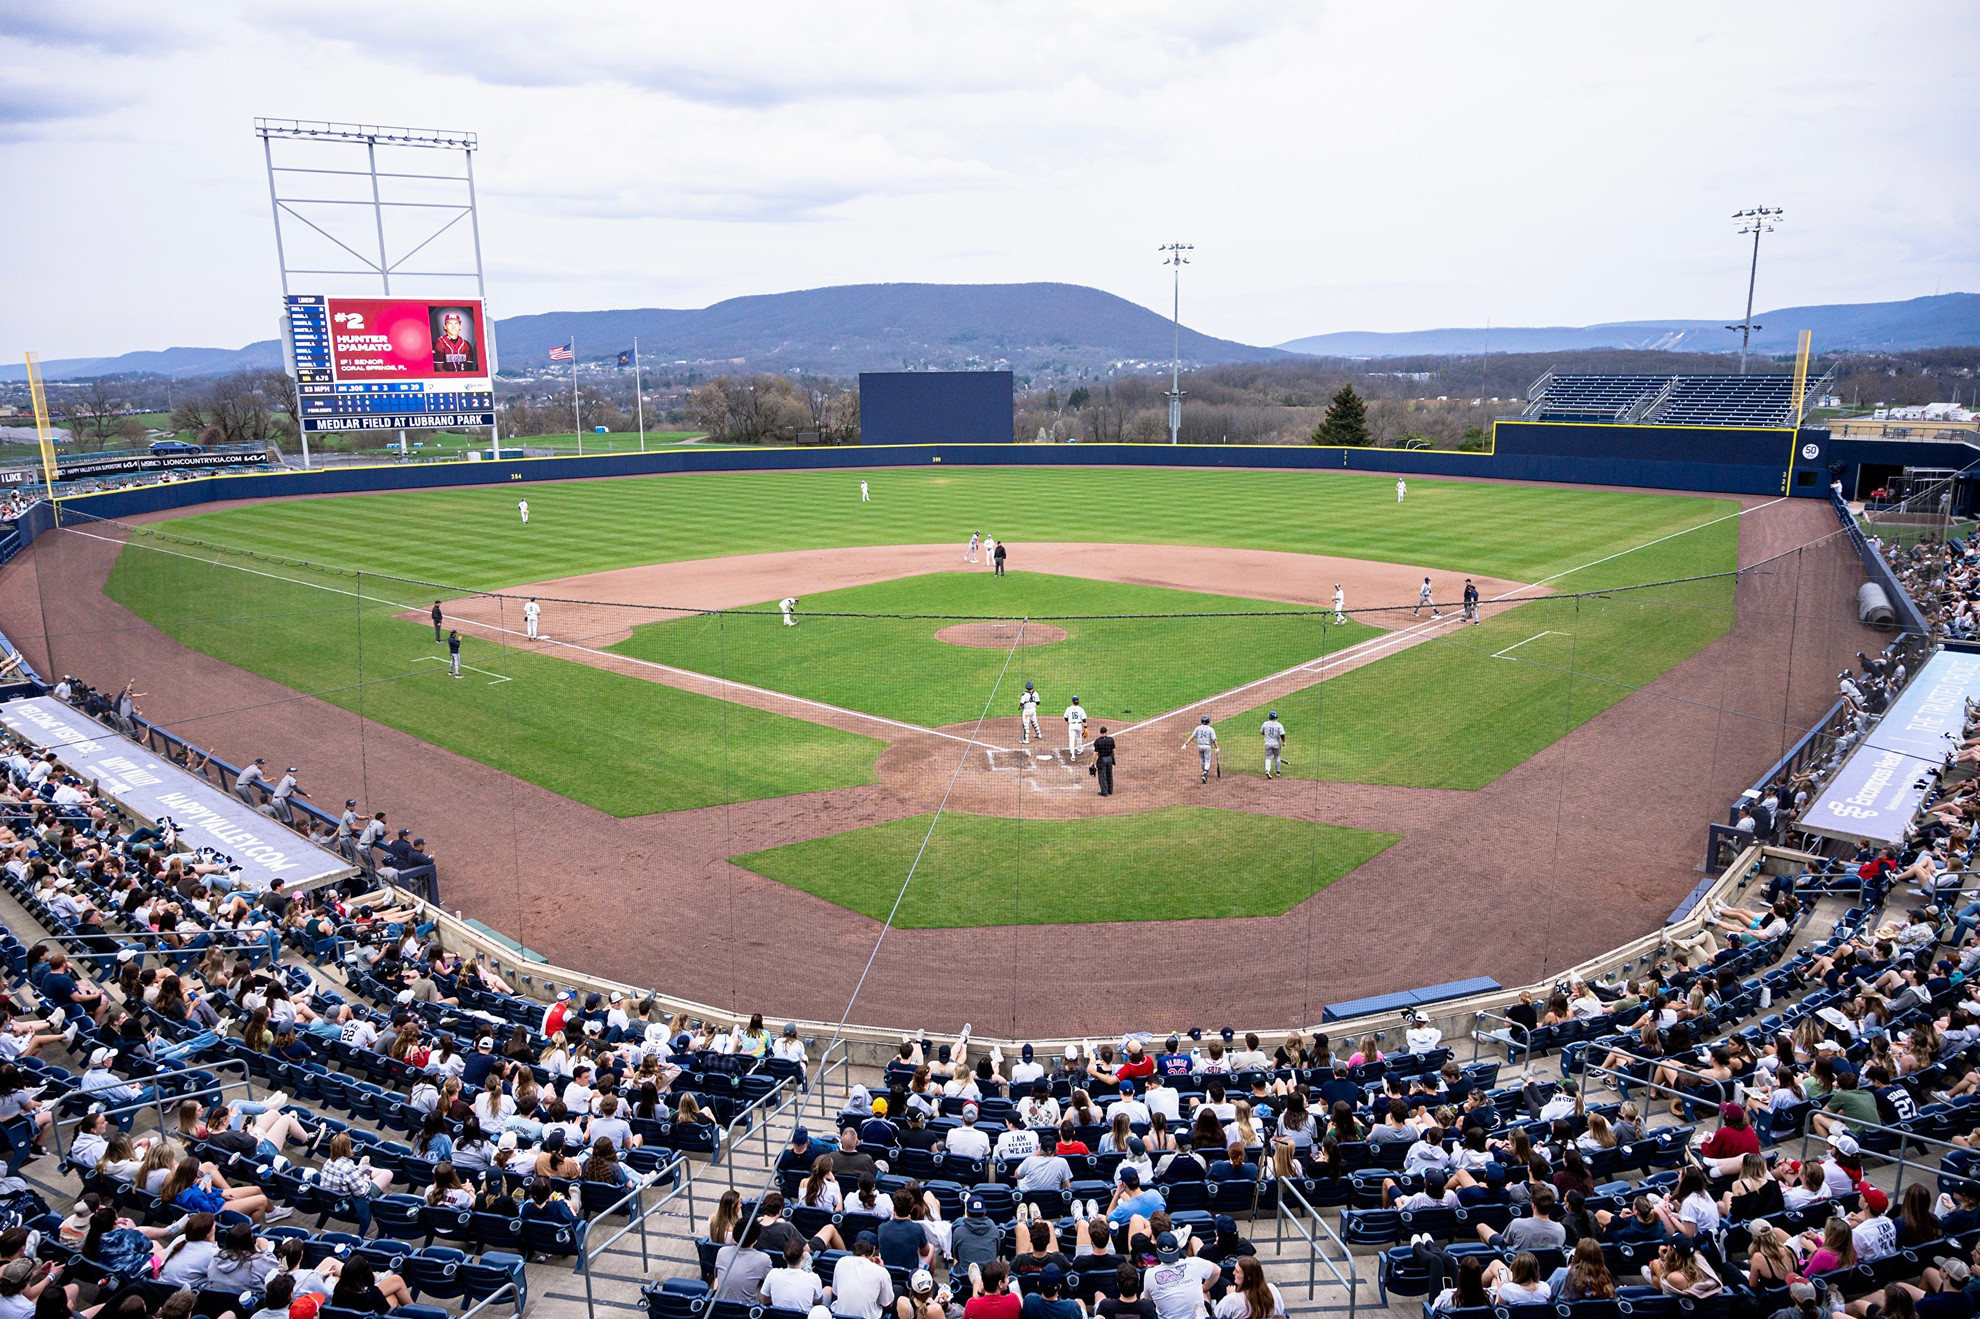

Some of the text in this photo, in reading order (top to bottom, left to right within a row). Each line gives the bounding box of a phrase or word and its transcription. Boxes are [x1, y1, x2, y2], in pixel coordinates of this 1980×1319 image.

[334, 312, 365, 330] #2
[336, 335, 388, 343] HUNTER
[338, 344, 392, 352] D'AMATO
[462, 399, 466, 407] 1
[317, 415, 482, 429] MEDLAR FIELD AT LUBRANO PARK
[163, 456, 242, 466] LIONCOUNTRYKIA.COM
[1, 472, 22, 483] I LIKE
[1916, 684, 1964, 716] TRUSTED
[13, 703, 66, 730] WELCOME
[1904, 715, 1944, 732] THE
[1845, 768, 1894, 806] Encompass
[156, 792, 300, 872] HAPPYVALLEY.COM
[342, 1029, 355, 1041] 22
